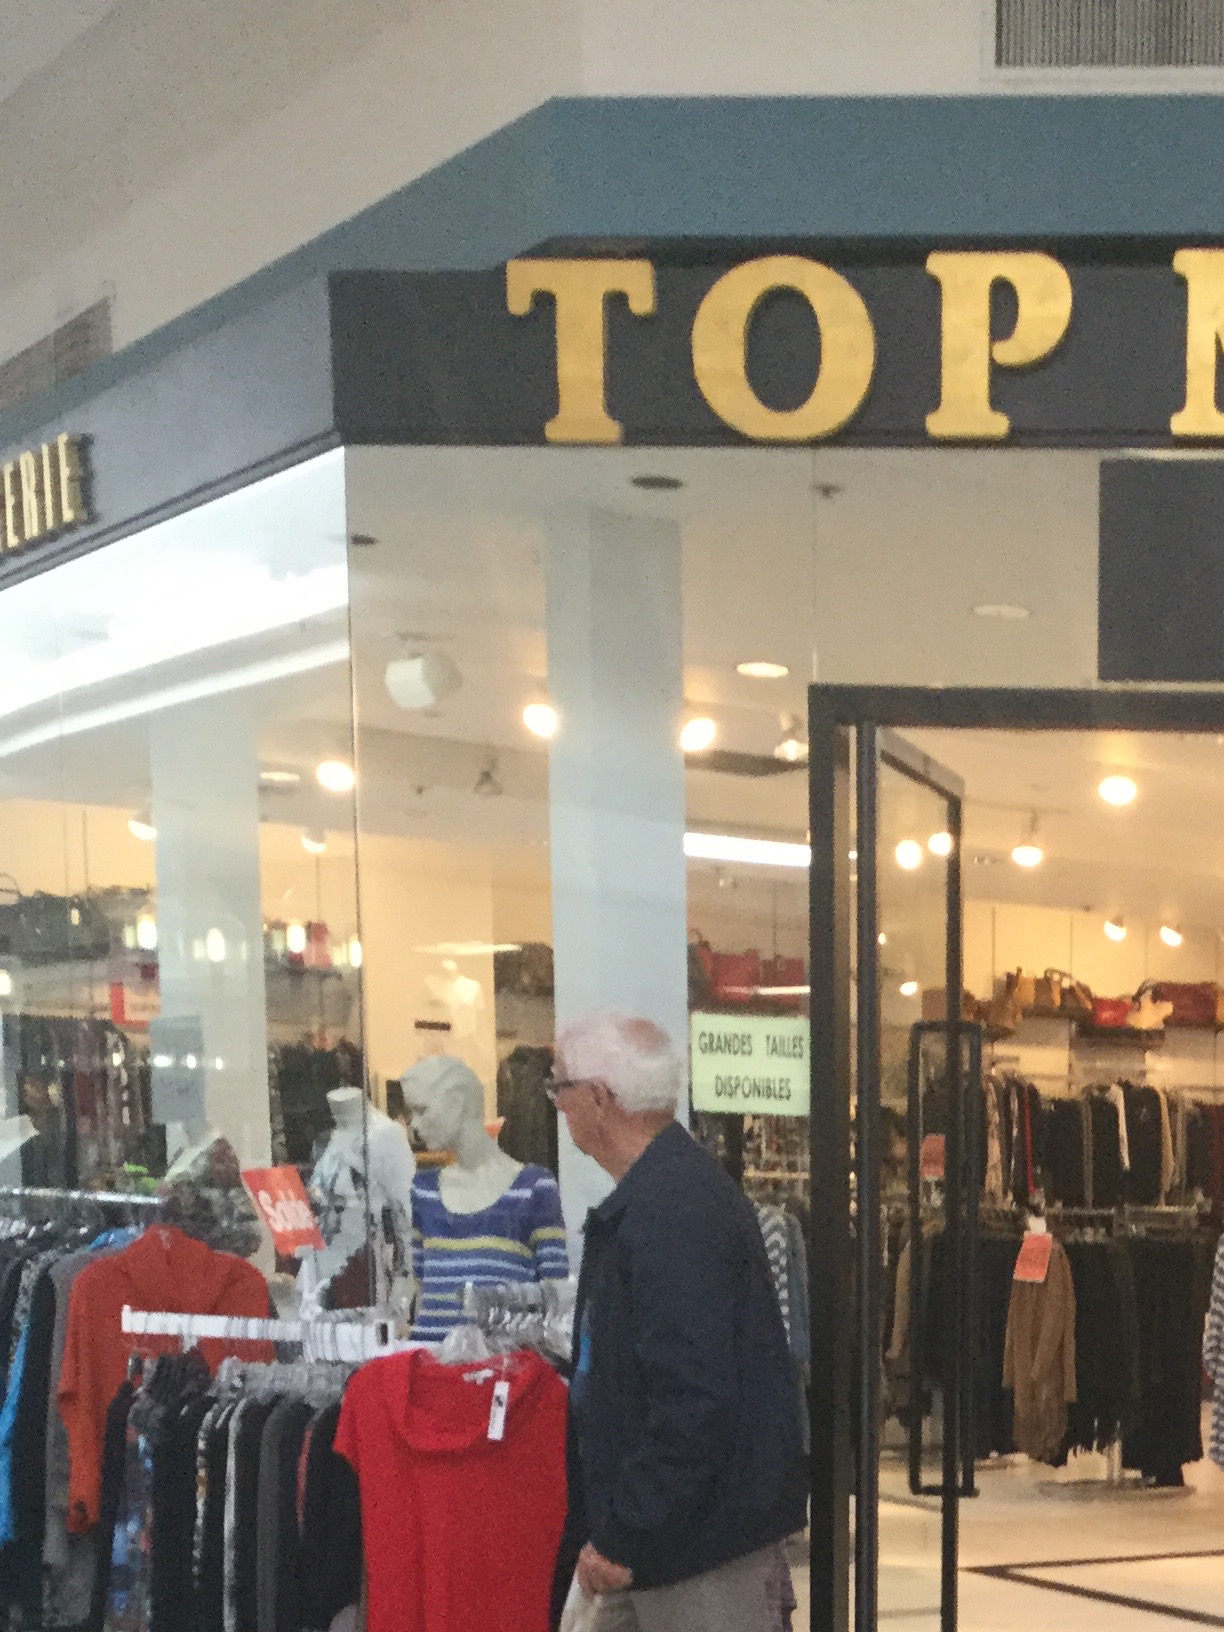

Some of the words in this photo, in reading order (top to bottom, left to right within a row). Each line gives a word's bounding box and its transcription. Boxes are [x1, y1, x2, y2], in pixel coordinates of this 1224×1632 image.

[505, 250, 1074, 444] TOP
[0, 431, 75, 553] ERIE
[698, 1031, 753, 1057] GRANDES
[765, 1034, 805, 1060] TAILLES
[714, 1075, 792, 1101] DISPONIBLES
